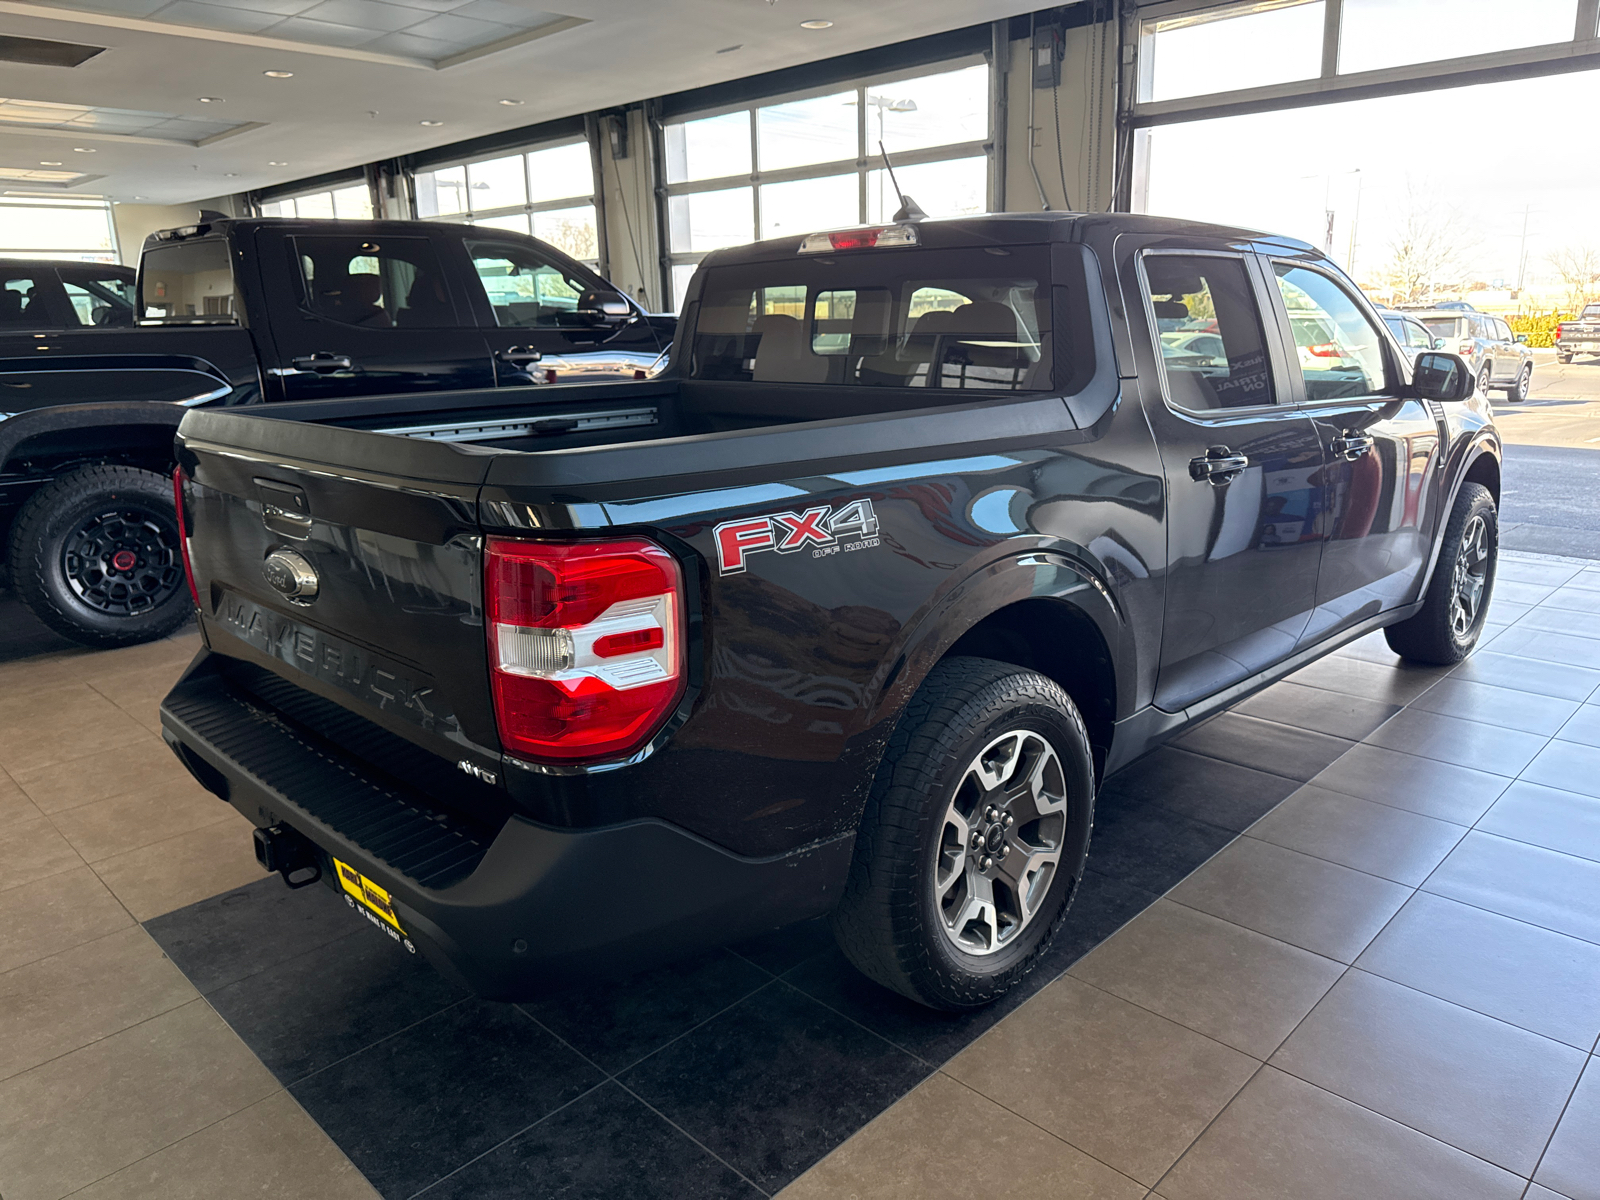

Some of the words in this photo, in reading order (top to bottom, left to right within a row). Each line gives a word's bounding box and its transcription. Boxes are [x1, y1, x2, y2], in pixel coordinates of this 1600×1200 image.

[712, 498, 880, 577] FX4
[812, 546, 840, 558] OFF
[844, 538, 880, 552] ROAD
[267, 563, 288, 588] Ford
[226, 598, 434, 717] MAVERICK
[457, 759, 497, 785] AWD
